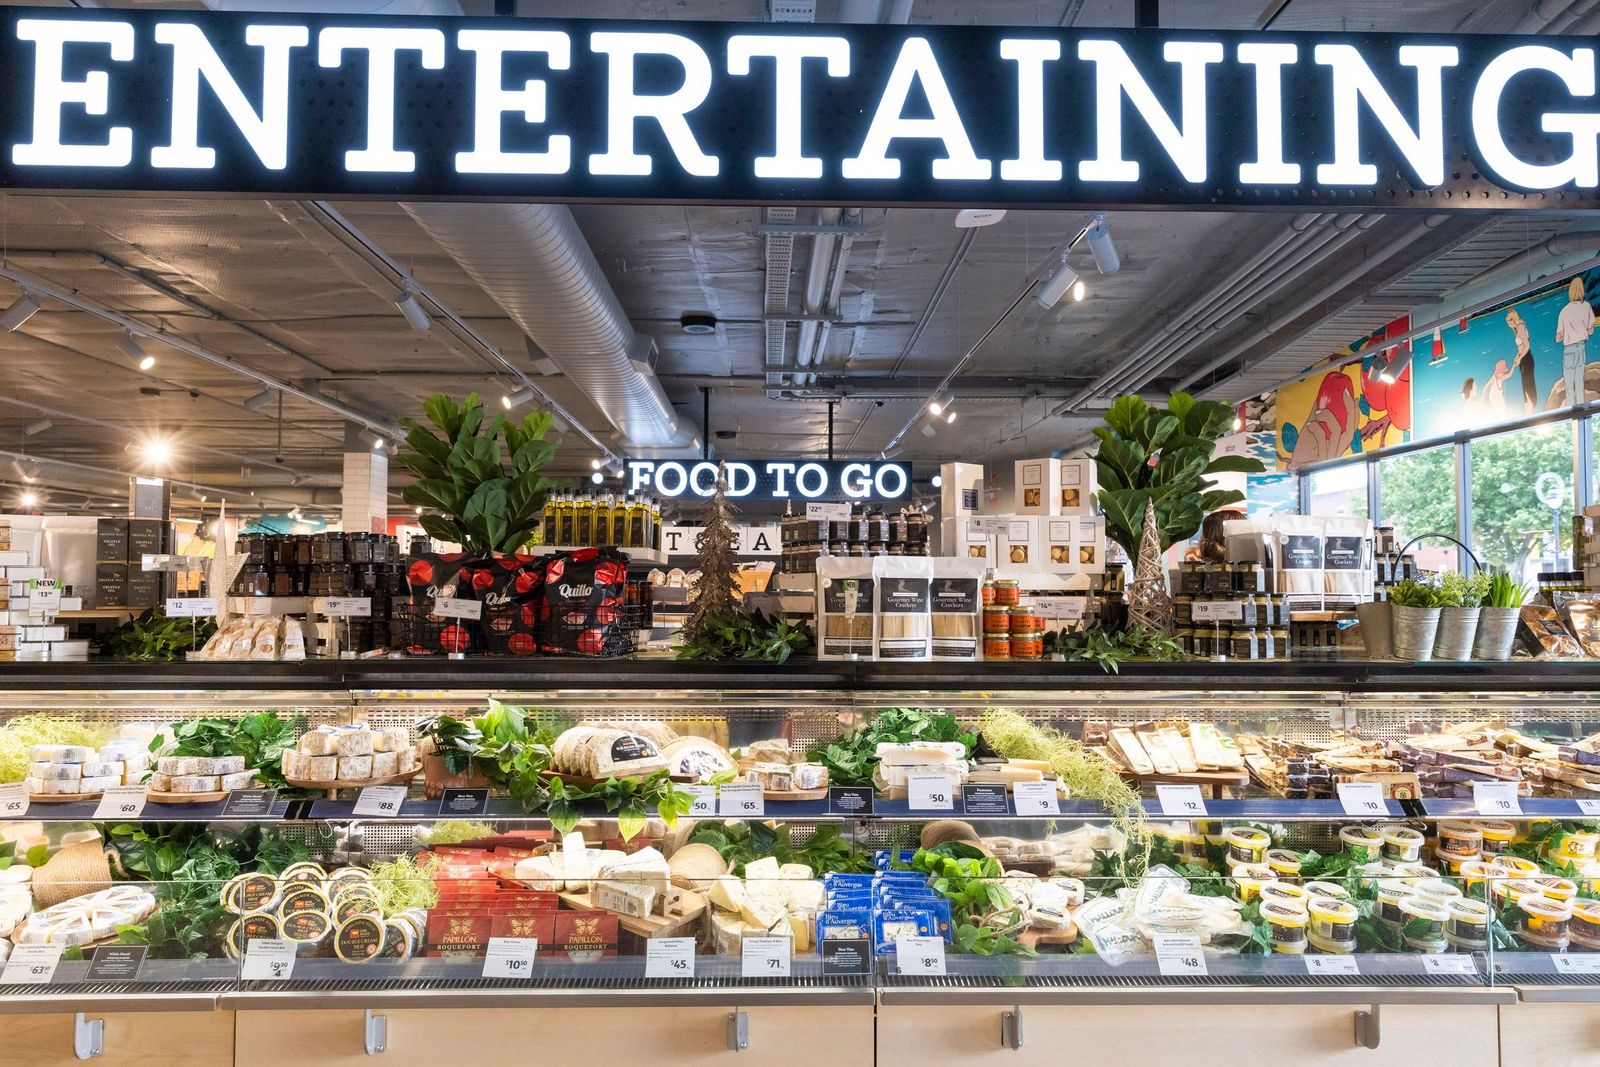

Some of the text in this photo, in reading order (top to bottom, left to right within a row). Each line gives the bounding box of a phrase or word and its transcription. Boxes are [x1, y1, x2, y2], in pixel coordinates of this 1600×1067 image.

[12, 18, 1600, 190] ENTERTAINING
[628, 461, 907, 498] FOOD TO GO
[426, 584, 457, 598] Quio
[558, 583, 594, 598] Quillo
[928, 793, 944, 803] $50
[378, 801, 394, 810] $88
[740, 801, 756, 810] $65
[1038, 800, 1049, 809] $9
[1362, 801, 1378, 810] $10
[1496, 800, 1511, 809] $10
[442, 934, 477, 943] PAPILLON
[569, 935, 603, 943] PAPILLON
[670, 959, 687, 969] $45
[766, 959, 780, 969] $71
[1180, 957, 1199, 967] $48
